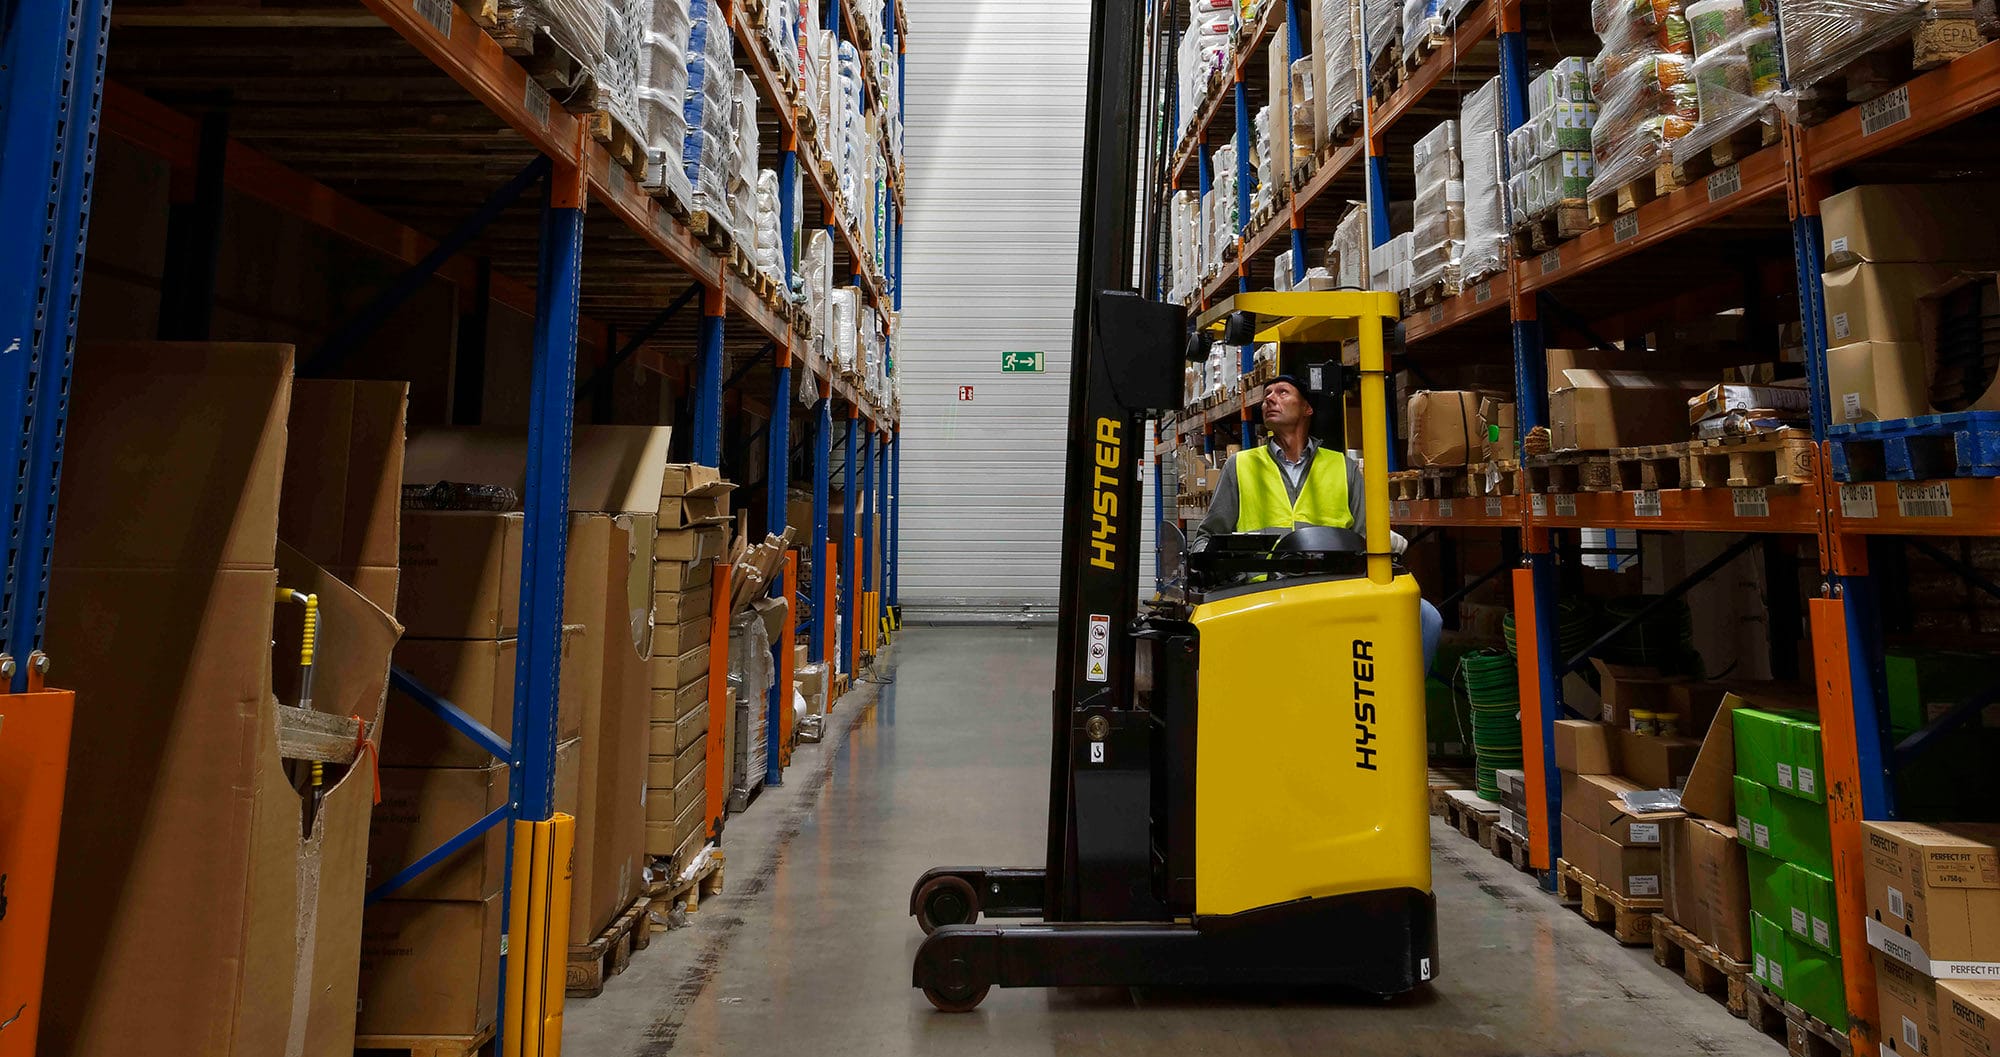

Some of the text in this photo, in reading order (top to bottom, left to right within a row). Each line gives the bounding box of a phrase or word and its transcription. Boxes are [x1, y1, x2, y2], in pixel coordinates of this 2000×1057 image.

[1943, 28, 1977, 42] EPAL
[1090, 417, 1121, 570] HYSTER
[1352, 639, 1377, 771] HYSTER
[1870, 833, 1899, 856] PERFECT FIT
[1930, 852, 1970, 861] PERFECT FIT
[1884, 938, 1904, 959] PERFECT
[1884, 959, 1913, 984] PERFECT FIT
[1951, 965, 2000, 975] PERFECT FIT
[1952, 1000, 1985, 1030] PERFECT FIT
